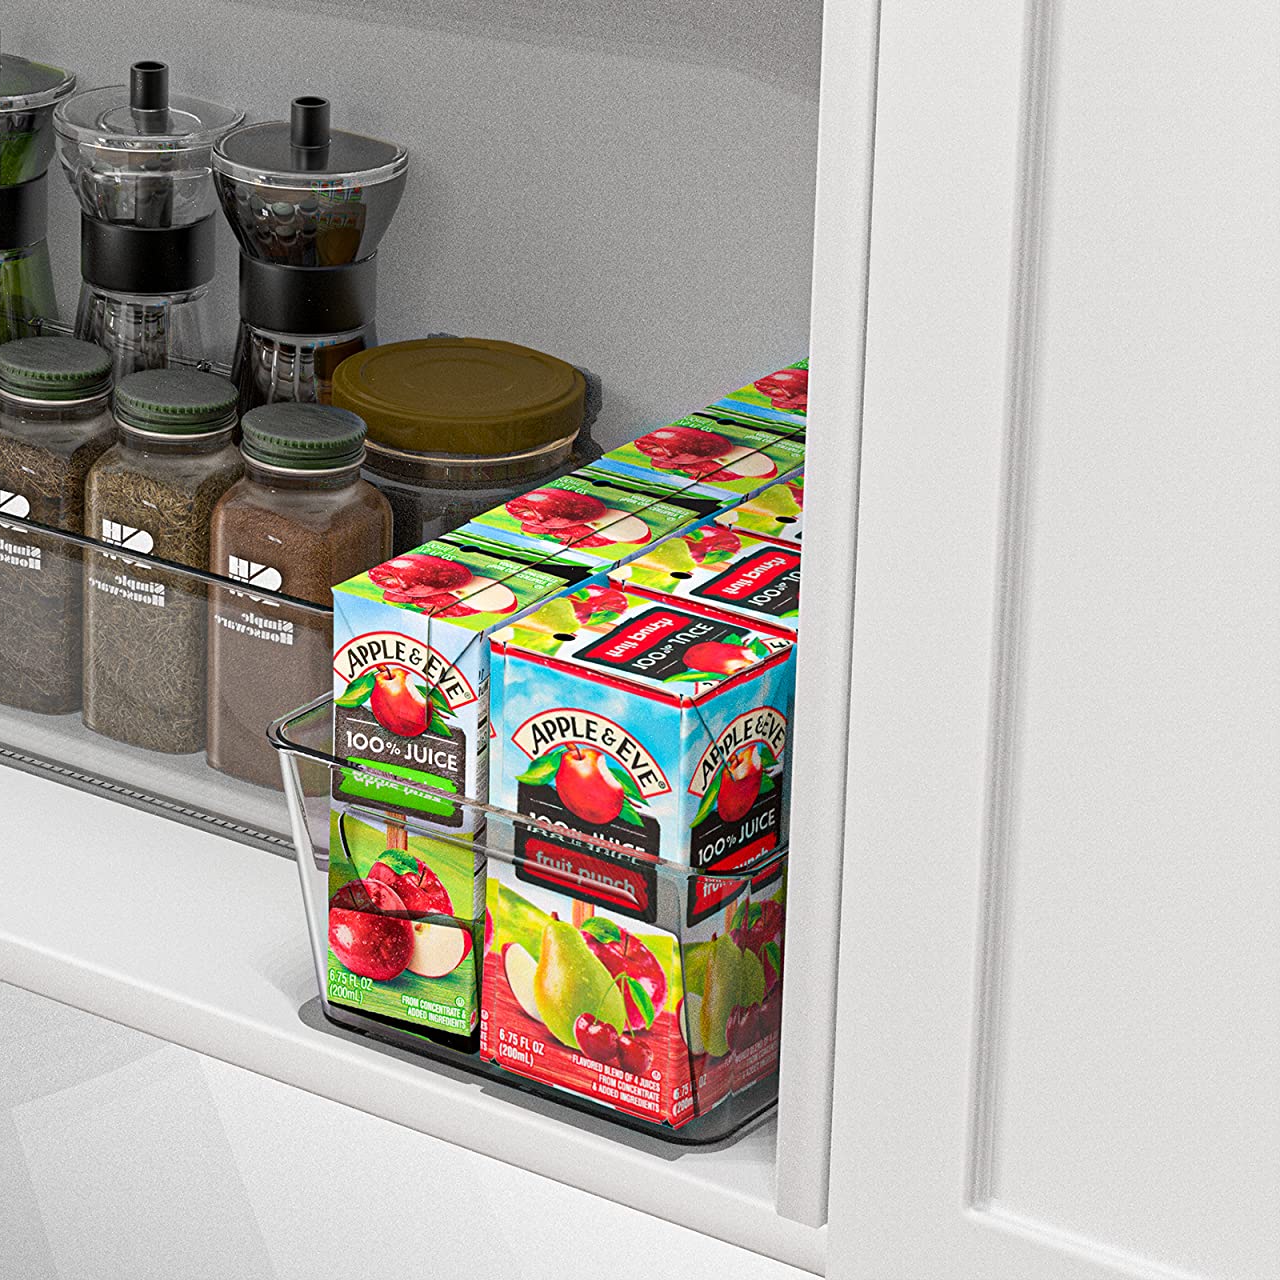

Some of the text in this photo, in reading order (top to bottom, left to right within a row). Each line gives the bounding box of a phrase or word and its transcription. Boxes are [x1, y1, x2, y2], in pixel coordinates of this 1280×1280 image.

[348, 638, 466, 702] APPLE & EVE
[345, 730, 458, 772] 100% JUICE
[532, 715, 659, 789] APPLE & EVE
[701, 722, 753, 793] APPLE
[698, 807, 777, 868] 100% JUICE
[534, 850, 637, 898] fruit punch
[329, 970, 374, 992] 6.75 FL OZ
[329, 984, 364, 1004] (200mL)
[401, 994, 467, 1020] FROM CONCENTRATE &
[407, 1007, 467, 1031] ADDED INGREDIENTS
[499, 1028, 545, 1056] 6.75 FL OZ
[499, 1044, 535, 1067] (200mL)
[572, 1054, 661, 1093] FLAVORED BLEND OF 4 JUICES
[598, 1074, 660, 1102] FROM CONCENTRATE
[598, 1083, 619, 1100] ADDED
[619, 1090, 660, 1114] INGREDIENTS
